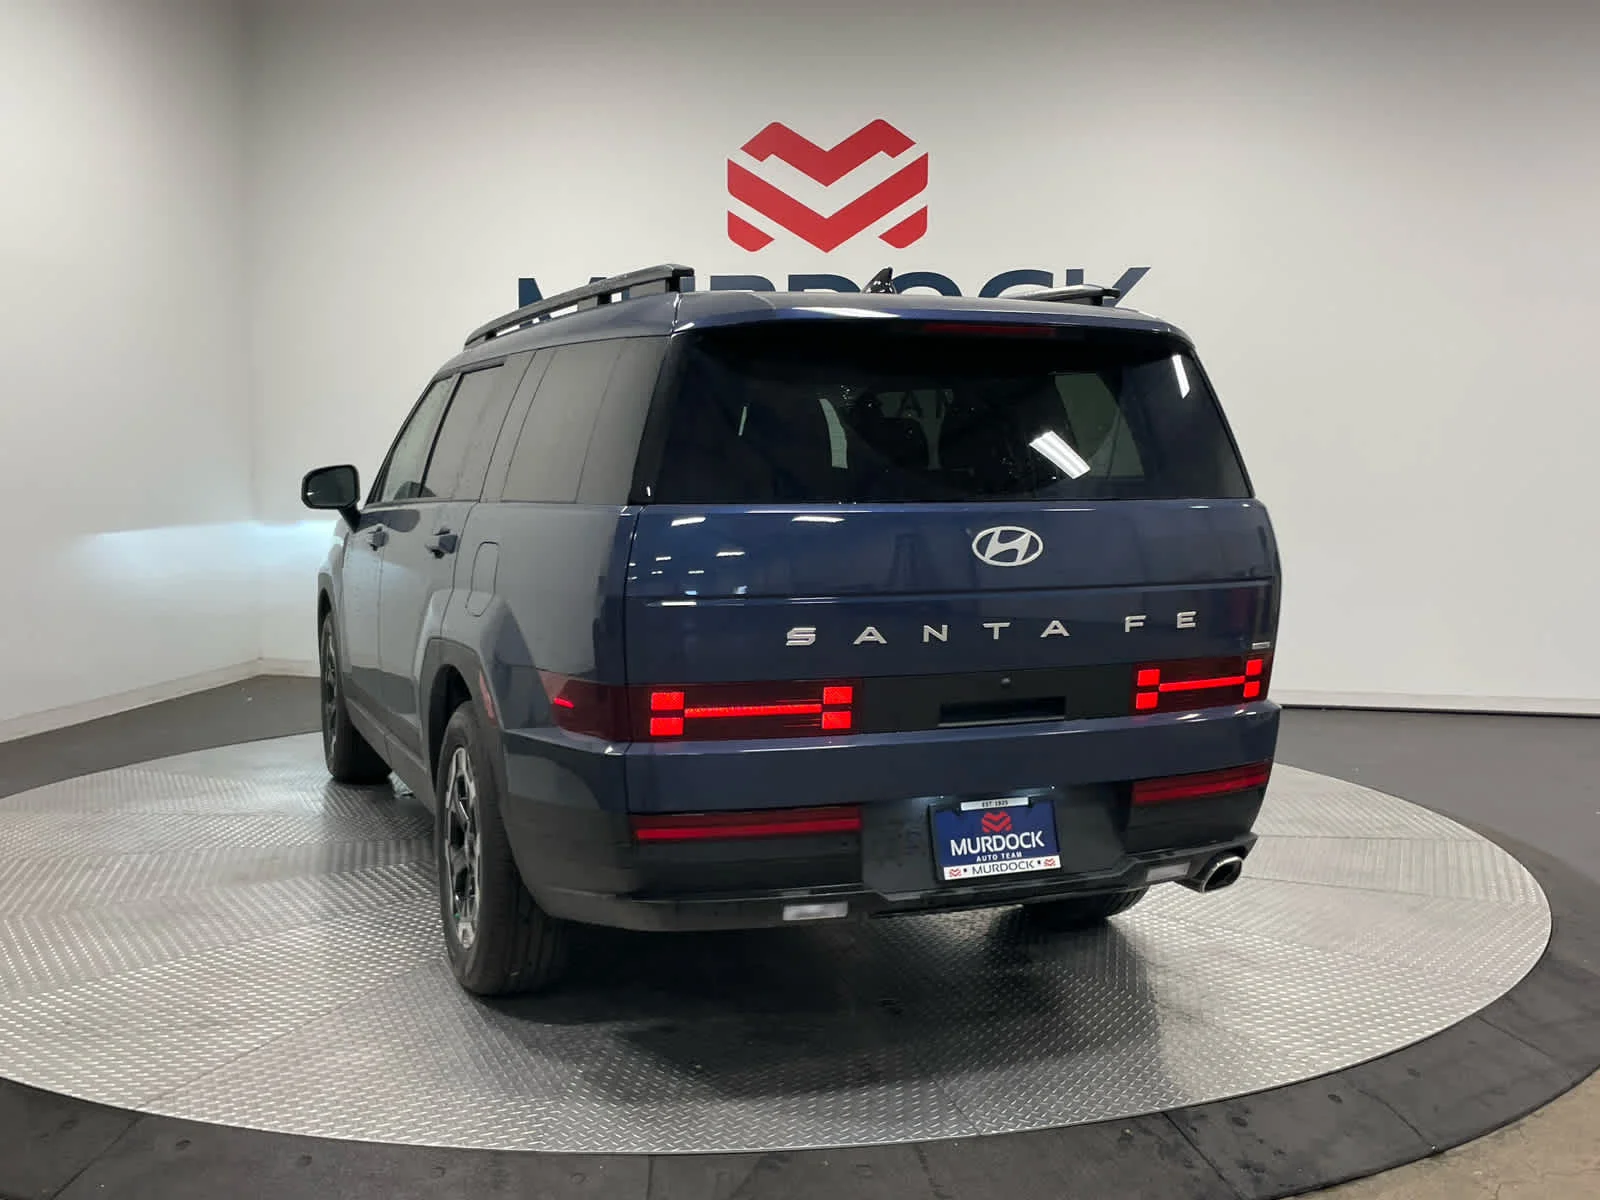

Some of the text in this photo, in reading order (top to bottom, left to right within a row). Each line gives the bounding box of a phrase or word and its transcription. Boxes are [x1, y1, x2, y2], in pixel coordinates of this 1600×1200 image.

[786, 611, 1197, 646] SANTA FE
[950, 830, 1045, 856] MURDOCK
[976, 851, 1023, 863] AUTO TEAM
[972, 860, 1035, 875] MURDOCK
